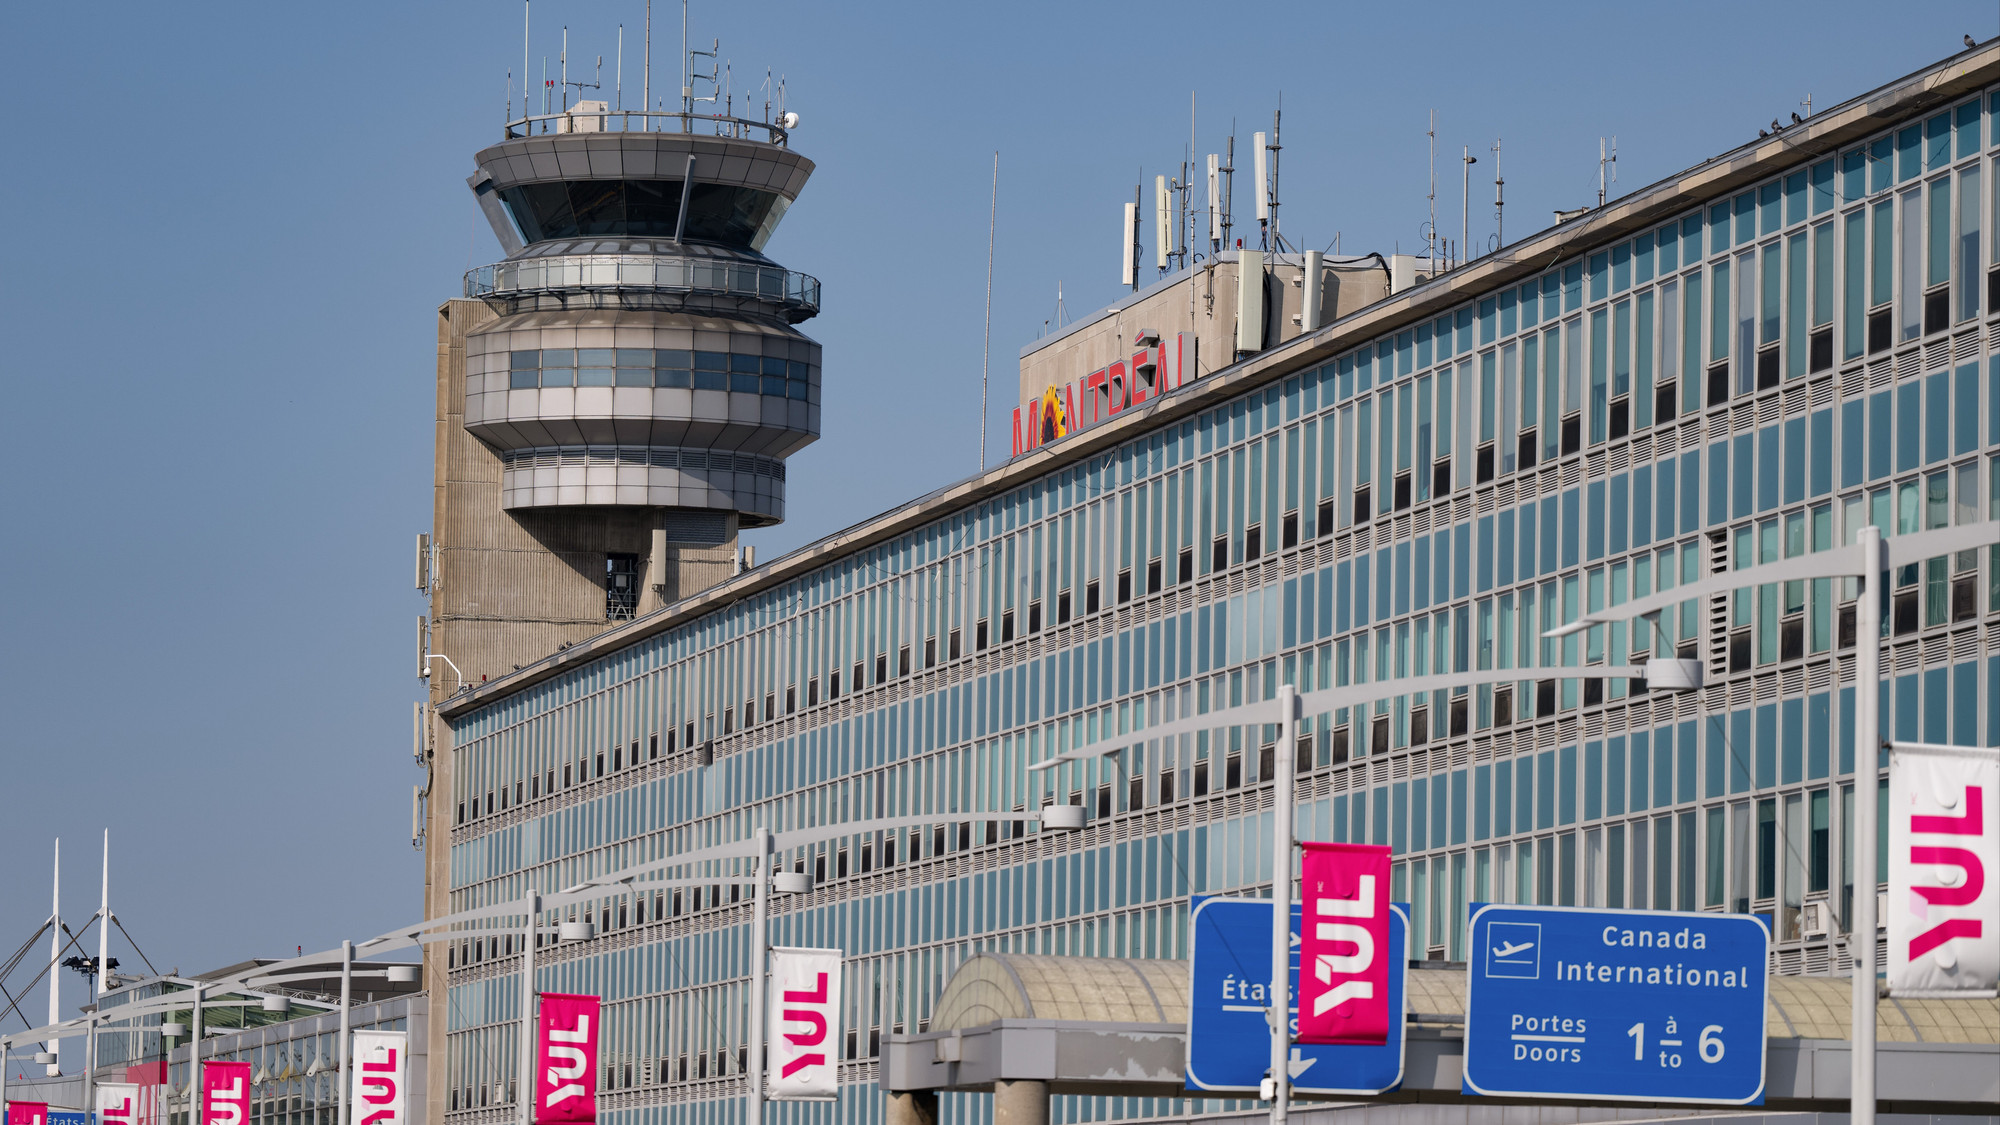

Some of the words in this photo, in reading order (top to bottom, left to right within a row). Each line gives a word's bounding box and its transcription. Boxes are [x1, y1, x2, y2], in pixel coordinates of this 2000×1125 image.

[1909, 785, 1984, 962] YUL
[1314, 874, 1376, 1018] YUL
[1602, 926, 1706, 950] Canada
[1557, 960, 1748, 989] International
[782, 972, 828, 1080] YUL
[1511, 1014, 1586, 1034] Portes
[1627, 1022, 1645, 1061] 1
[1665, 1016, 1677, 1035] à
[546, 1014, 589, 1109] YUL
[1514, 1044, 1582, 1063] Doors
[1659, 1050, 1682, 1069] to
[1698, 1024, 1725, 1064] 6
[211, 1077, 243, 1125] UL
[361, 1048, 397, 1125] YUL
